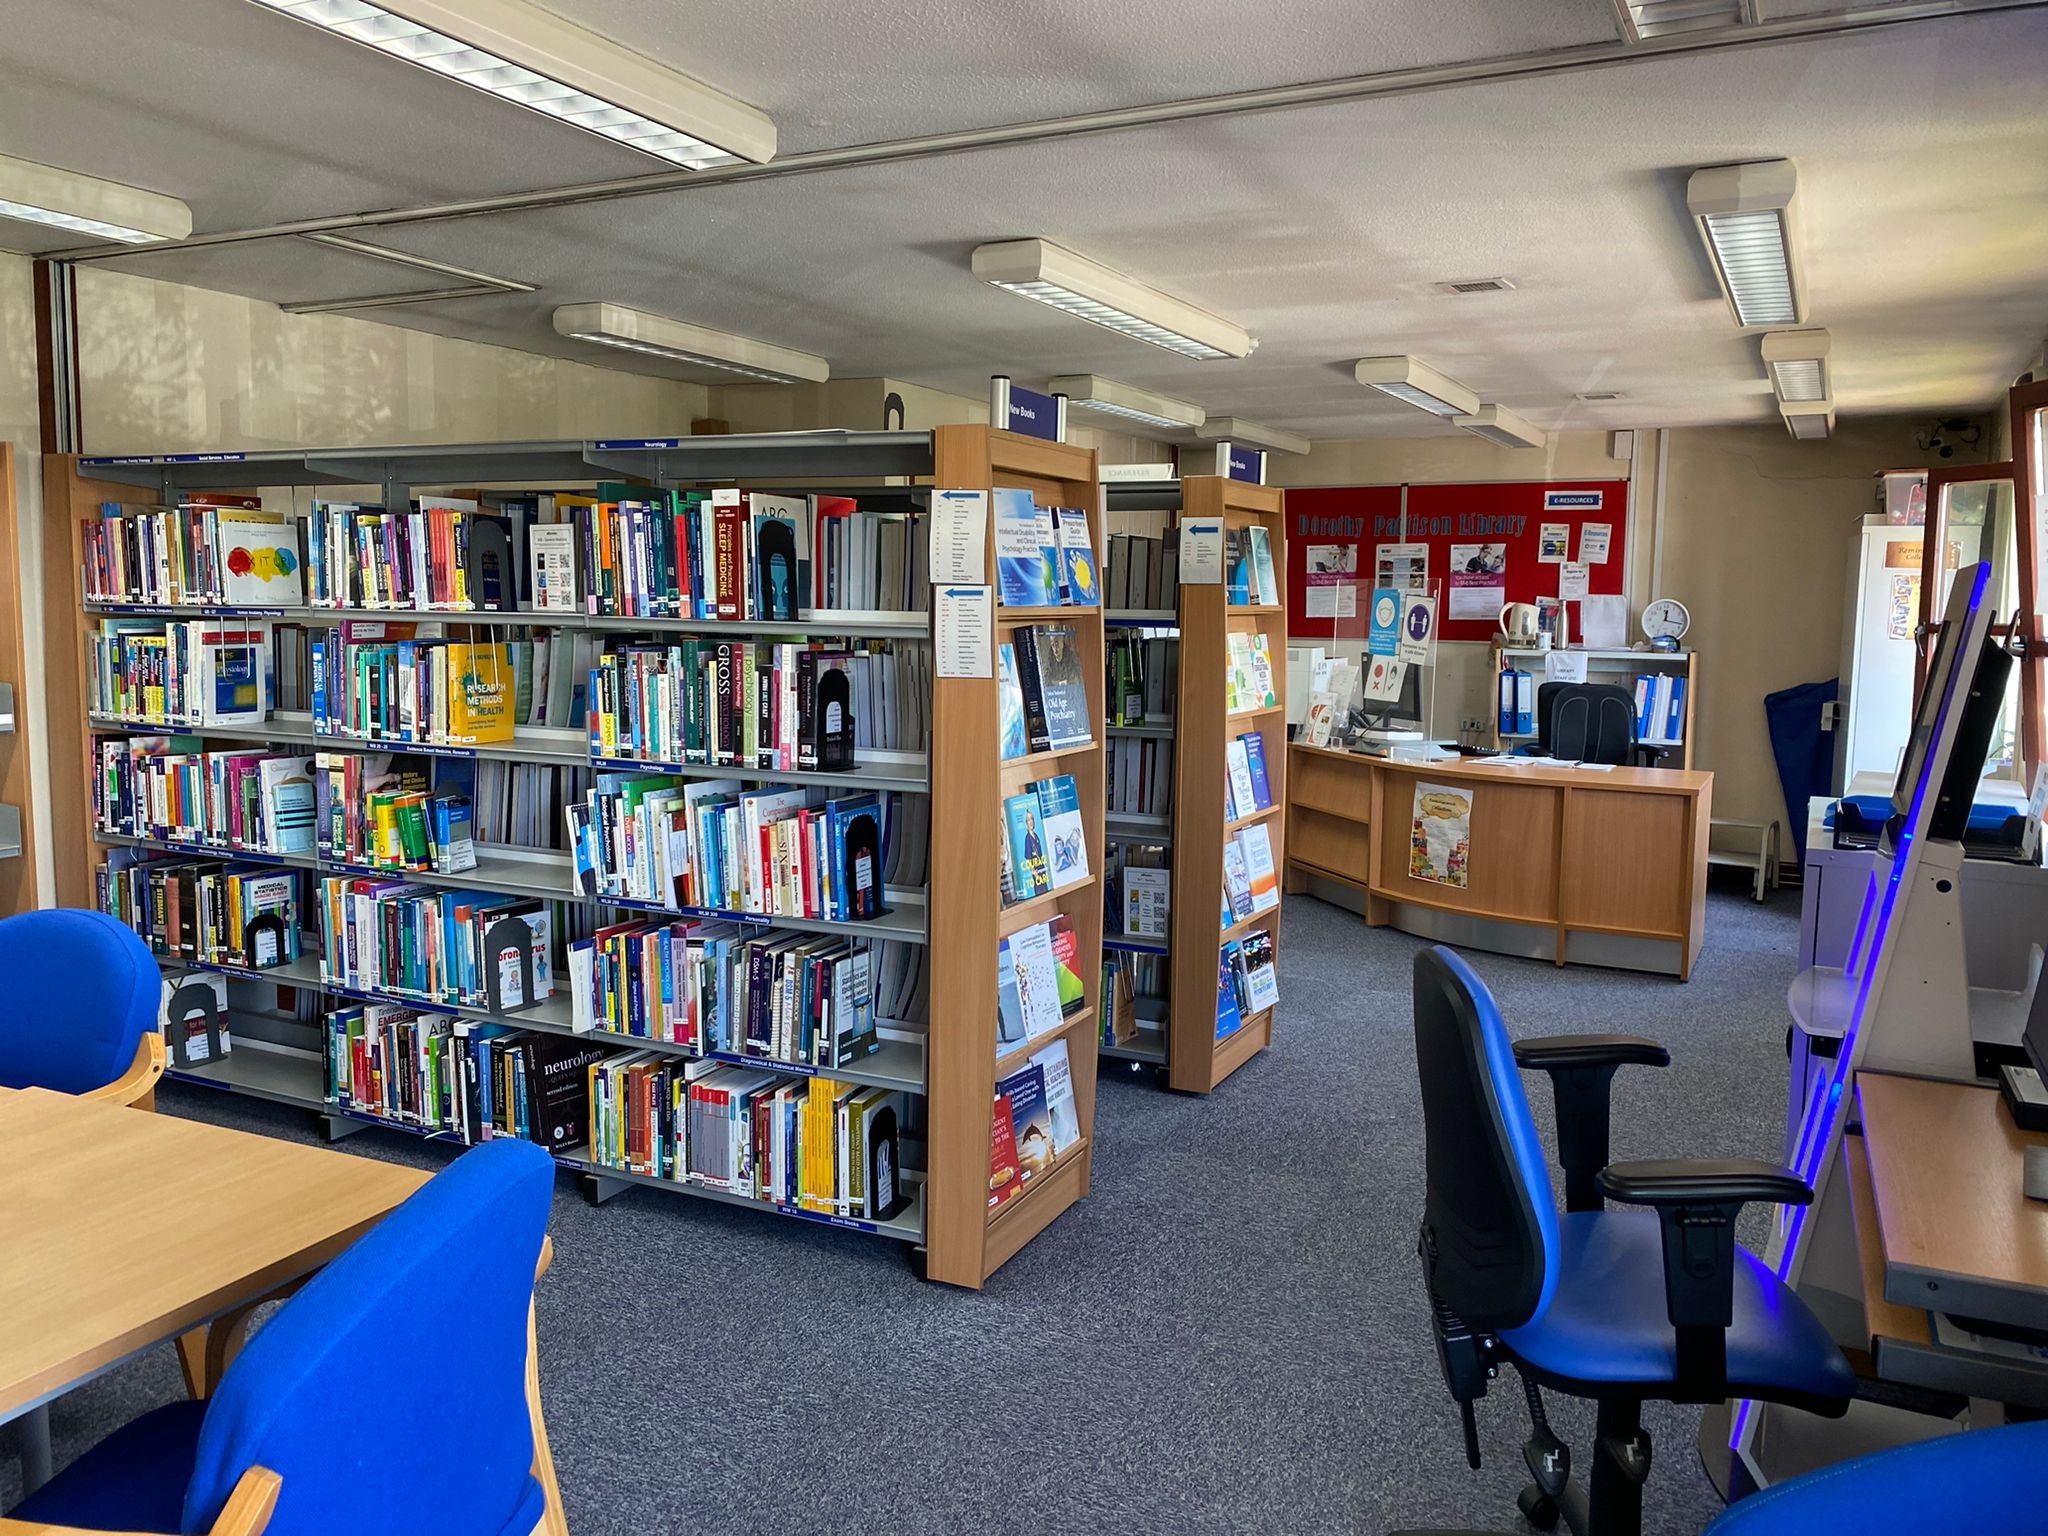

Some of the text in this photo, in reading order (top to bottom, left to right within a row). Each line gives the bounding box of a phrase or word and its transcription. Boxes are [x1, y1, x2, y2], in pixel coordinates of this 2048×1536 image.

[1010, 403, 1036, 420] New Books
[1236, 460, 1246, 470] Books
[1298, 511, 1528, 538] Dorothy Pattison Library
[1002, 544, 1022, 554] Psychology
[718, 523, 727, 597] SLEEP MEDICINE
[718, 645, 730, 695] GROSS
[466, 684, 506, 694] RESEARCH
[744, 659, 754, 715] psychology
[467, 695, 503, 705] METHODS
[1048, 698, 1068, 710] Old Age
[477, 707, 504, 716] HEALTH
[1050, 710, 1076, 724] Psychiatry
[603, 826, 611, 863] Psychology
[779, 842, 788, 864] SIX
[254, 886, 287, 895] STATISTICS
[744, 915, 770, 924] Personality
[544, 1048, 604, 1075] neurology
[740, 1056, 768, 1066] Diagnostical
[772, 1062, 794, 1071] Statistical
[844, 1218, 860, 1228] Books
